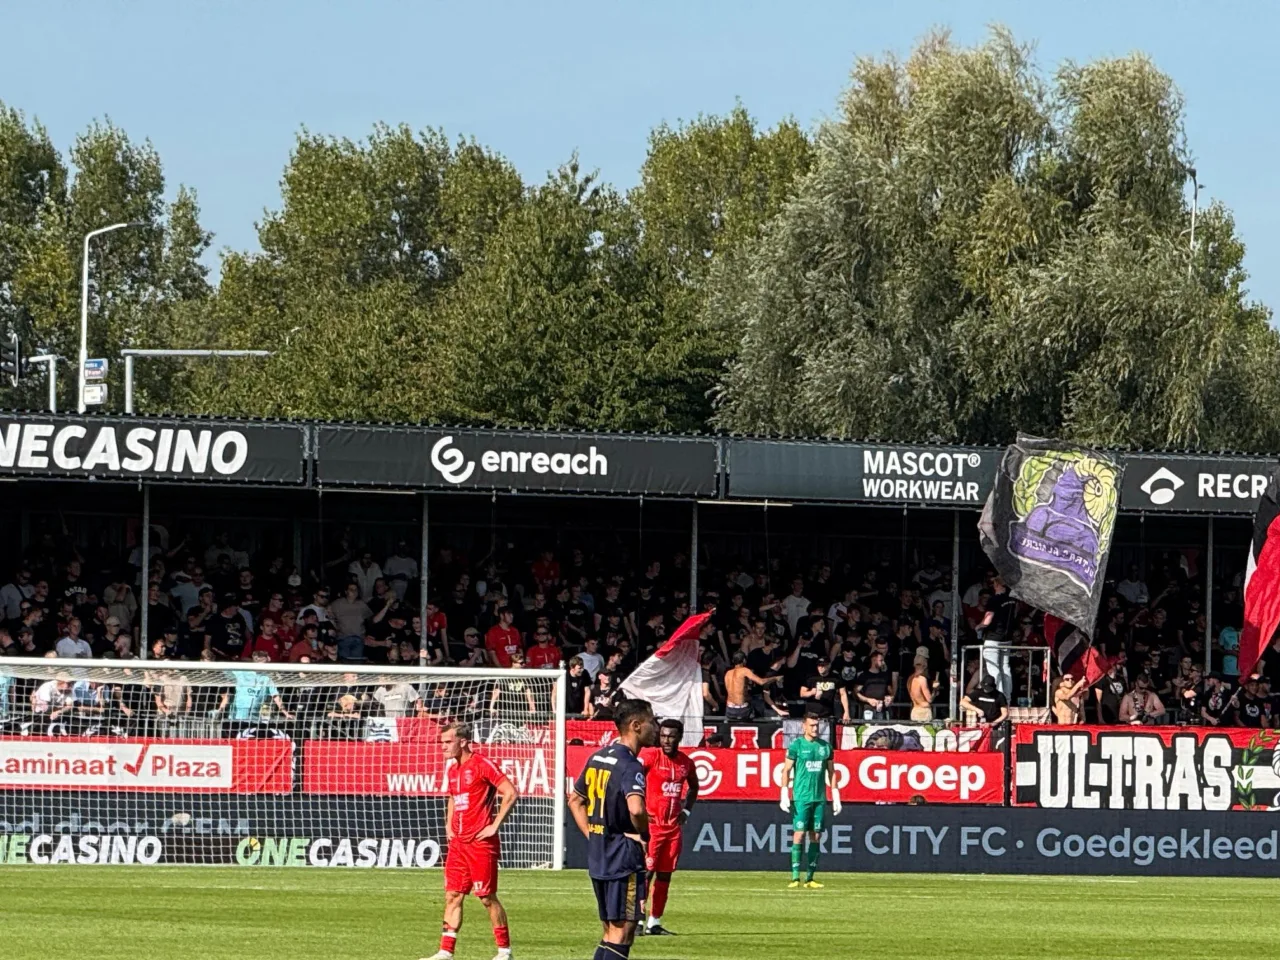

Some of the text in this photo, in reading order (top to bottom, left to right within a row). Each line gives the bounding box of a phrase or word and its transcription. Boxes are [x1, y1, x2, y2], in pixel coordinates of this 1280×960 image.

[481, 446, 608, 475] enreach
[863, 479, 979, 500] WORKWEAR
[151, 754, 221, 778] Plaza
[736, 751, 986, 799] Fleo Groep
[1037, 734, 1233, 810] ULTRAS
[235, 836, 440, 868] ONECASINO
[864, 824, 948, 856] CITY
[960, 826, 1007, 857] FC
[1036, 827, 1278, 866] Goedgekleed
